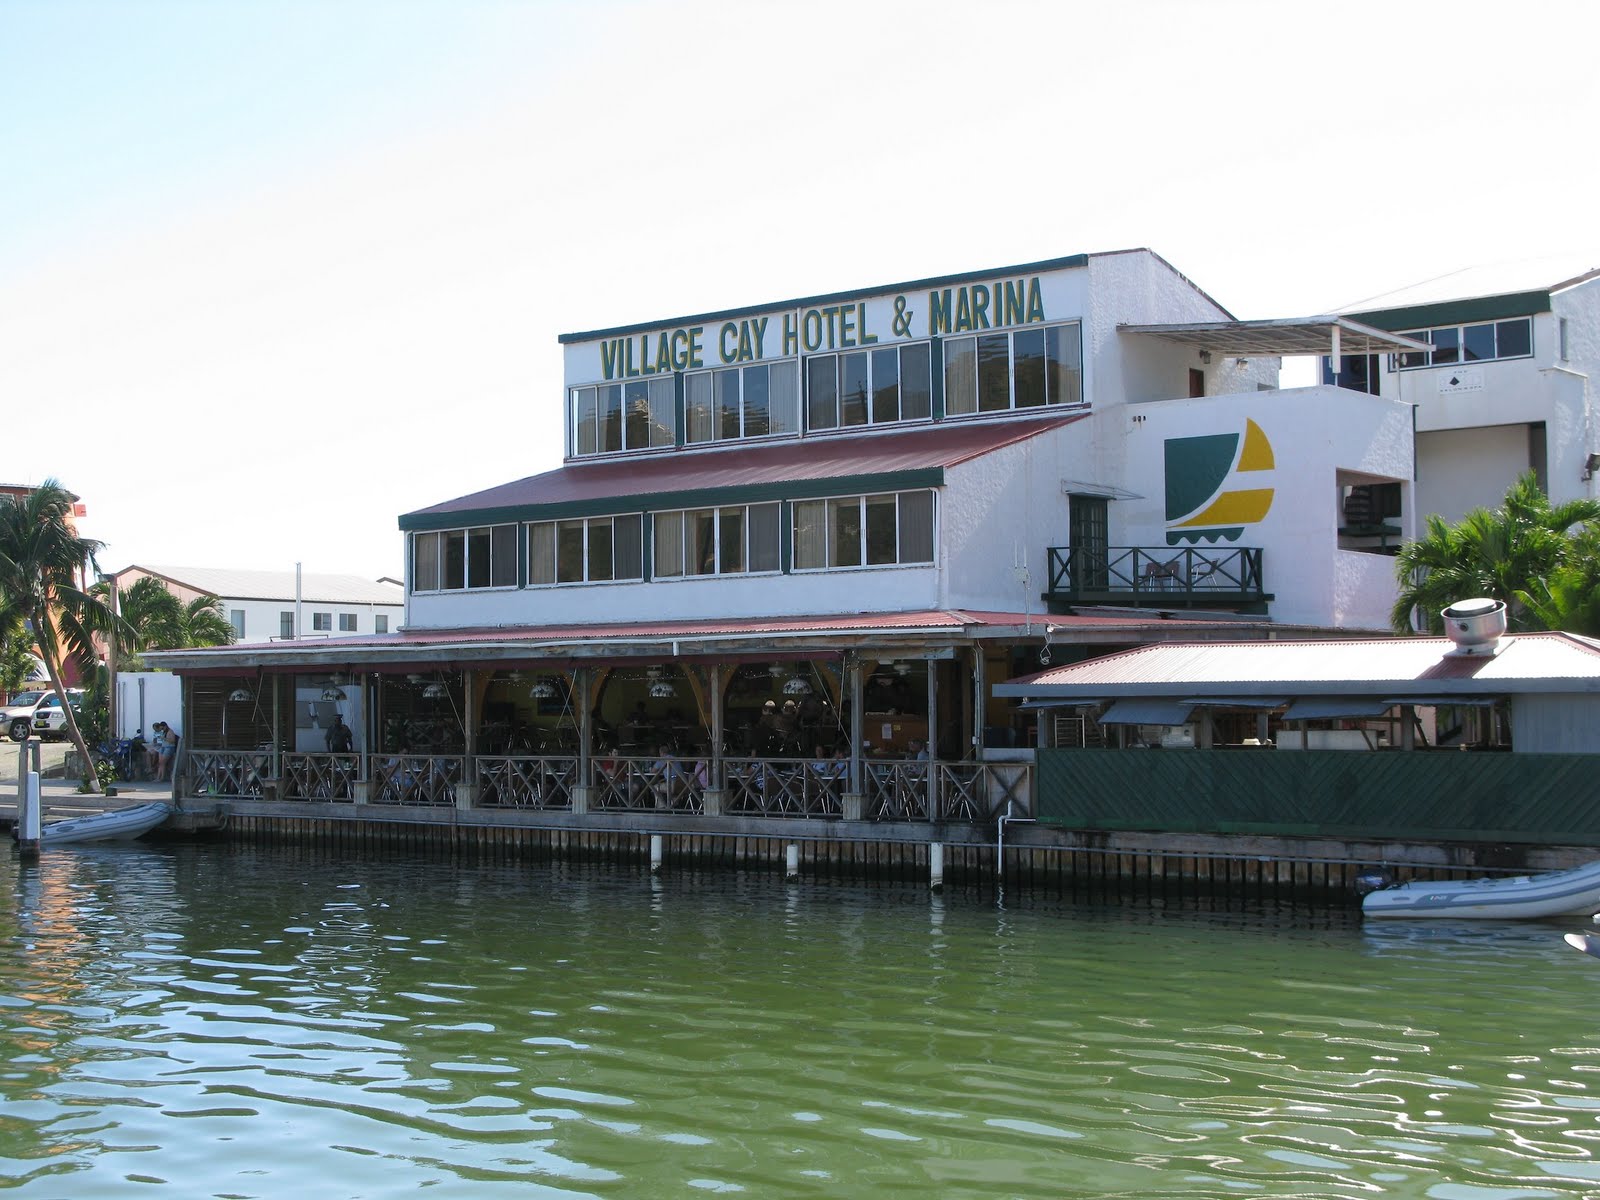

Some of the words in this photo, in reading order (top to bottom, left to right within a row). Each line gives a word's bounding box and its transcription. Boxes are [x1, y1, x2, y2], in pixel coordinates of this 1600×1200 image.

[600, 326, 704, 380] VILLAGE
[719, 317, 769, 364] CAY
[782, 302, 878, 355] HOTEL
[892, 295, 914, 338] &
[928, 277, 1046, 336] MARINA
